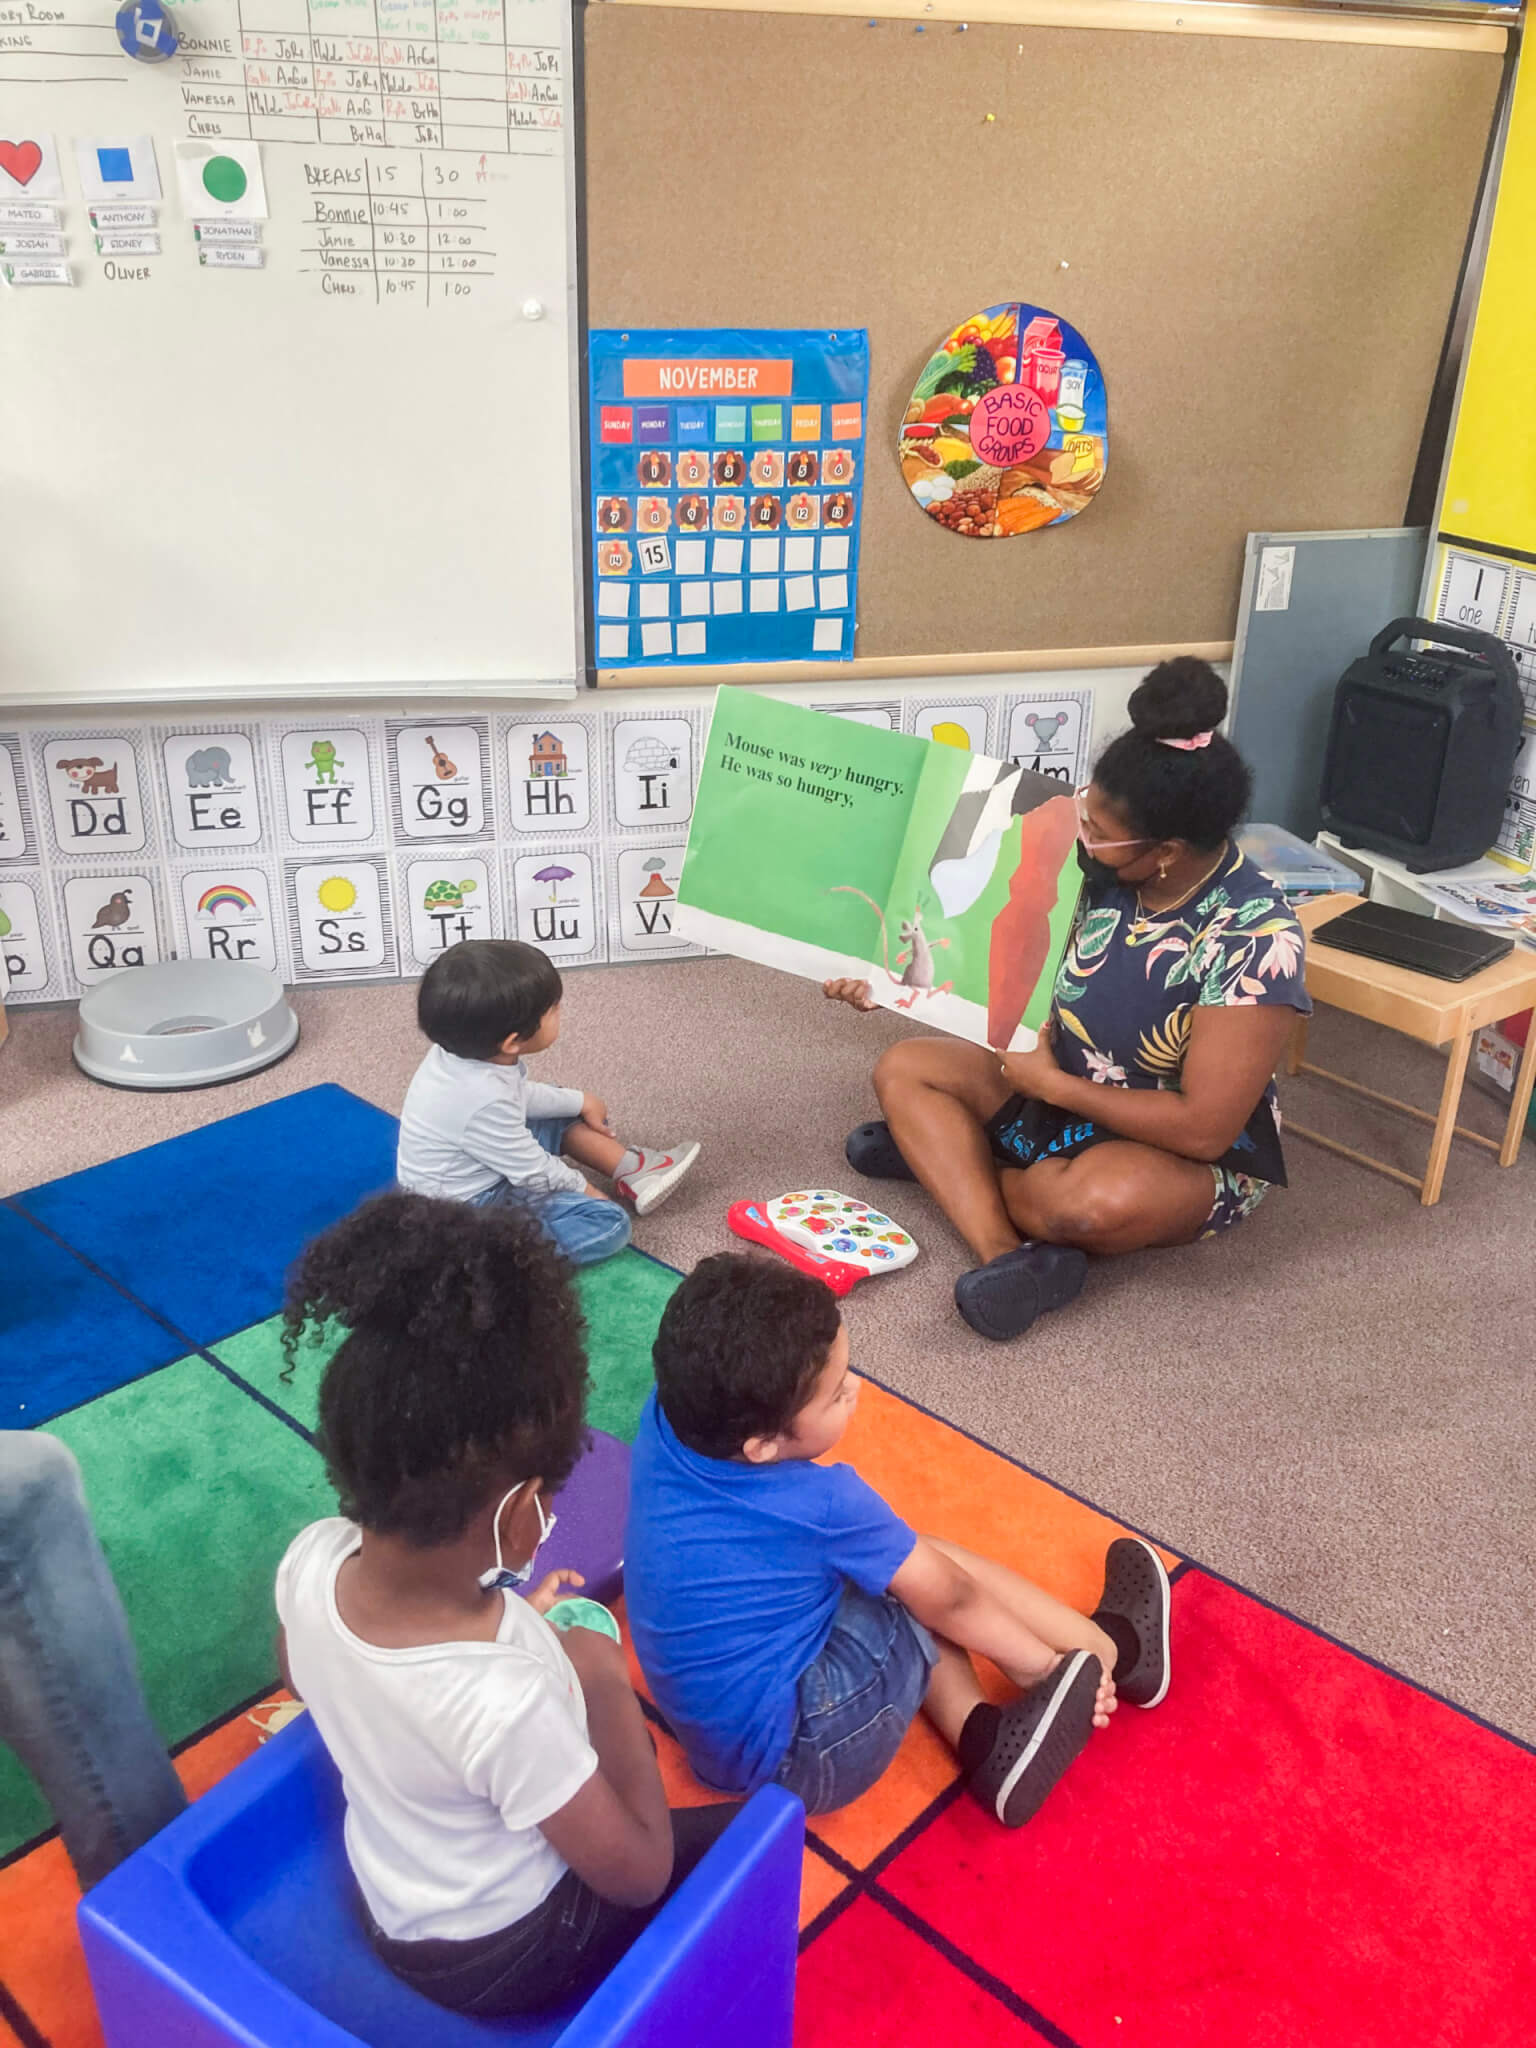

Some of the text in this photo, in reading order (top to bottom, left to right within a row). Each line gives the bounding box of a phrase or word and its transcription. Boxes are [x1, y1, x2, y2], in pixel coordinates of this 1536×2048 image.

[304, 163, 361, 185] BREAKS
[377, 166, 397, 182] 15
[435, 166, 460, 184] 30
[102, 212, 145, 222] ANTHONY
[203, 226, 252, 236] JONATHAN
[659, 367, 759, 389] NOVEMBER
[983, 392, 1042, 418] BASIC
[604, 420, 631, 430] SUNDAY
[641, 420, 666, 429] MONDAY
[987, 416, 1034, 437] FOOD
[978, 436, 1035, 462] GROUPS
[725, 511, 735, 521] 10
[761, 510, 770, 521] 11
[797, 509, 807, 519] 12
[832, 507, 843, 518] 13
[611, 545, 664, 565] 14 15
[1459, 604, 1483, 625] one
[720, 754, 854, 808] He was so hungry,
[724, 732, 905, 797] Mouse was very hungry.
[307, 788, 353, 825] Ff
[417, 784, 468, 827] Gg
[526, 779, 574, 815] Hh
[638, 775, 667, 809] Ii
[71, 798, 127, 836] Dd
[190, 793, 242, 830] Ee
[319, 919, 365, 953] Ss
[430, 913, 472, 949] Tt
[533, 907, 580, 941] Uu
[208, 926, 256, 960] Rr
